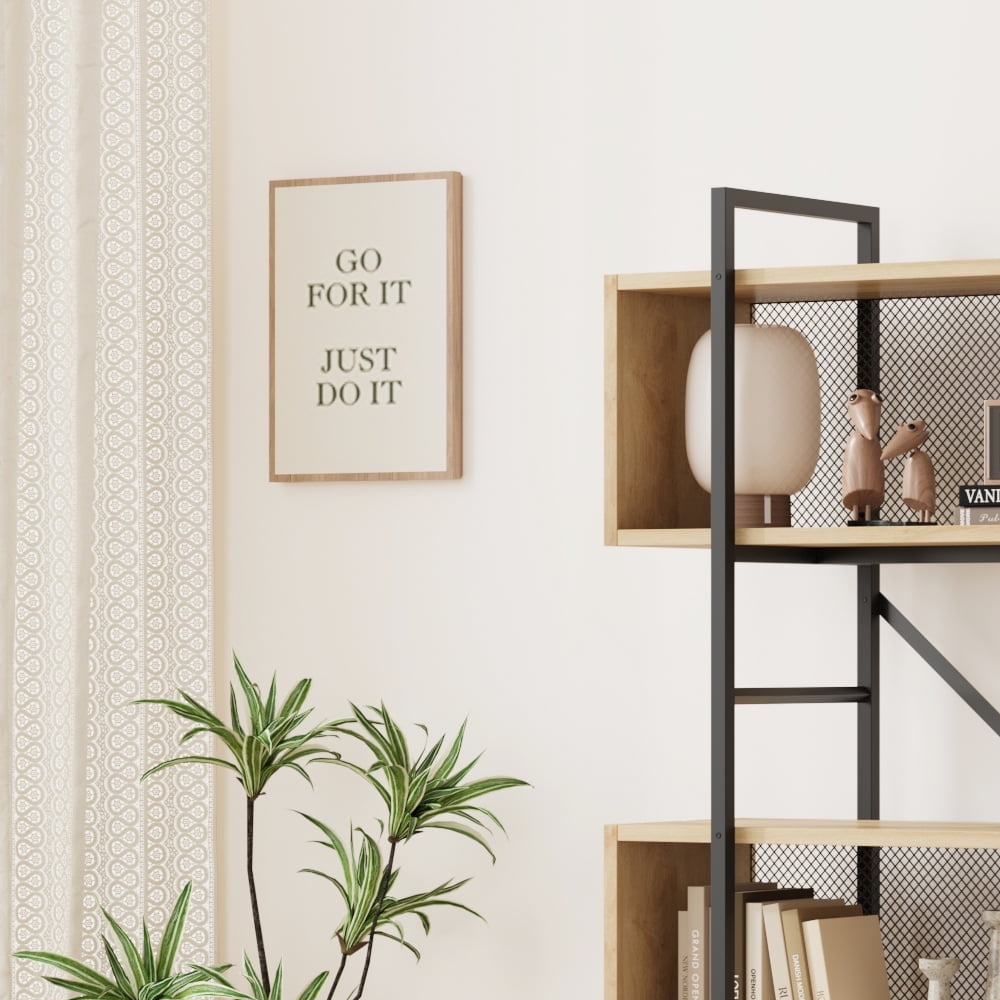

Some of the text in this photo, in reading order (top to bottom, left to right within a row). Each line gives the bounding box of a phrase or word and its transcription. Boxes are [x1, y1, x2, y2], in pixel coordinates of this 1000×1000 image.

[336, 248, 383, 273] GO
[307, 280, 413, 308] FOR IT
[320, 347, 398, 373] JUST
[317, 380, 403, 406] DO IT
[692, 929, 700, 969] GRAND
[792, 954, 802, 981] DANISH
